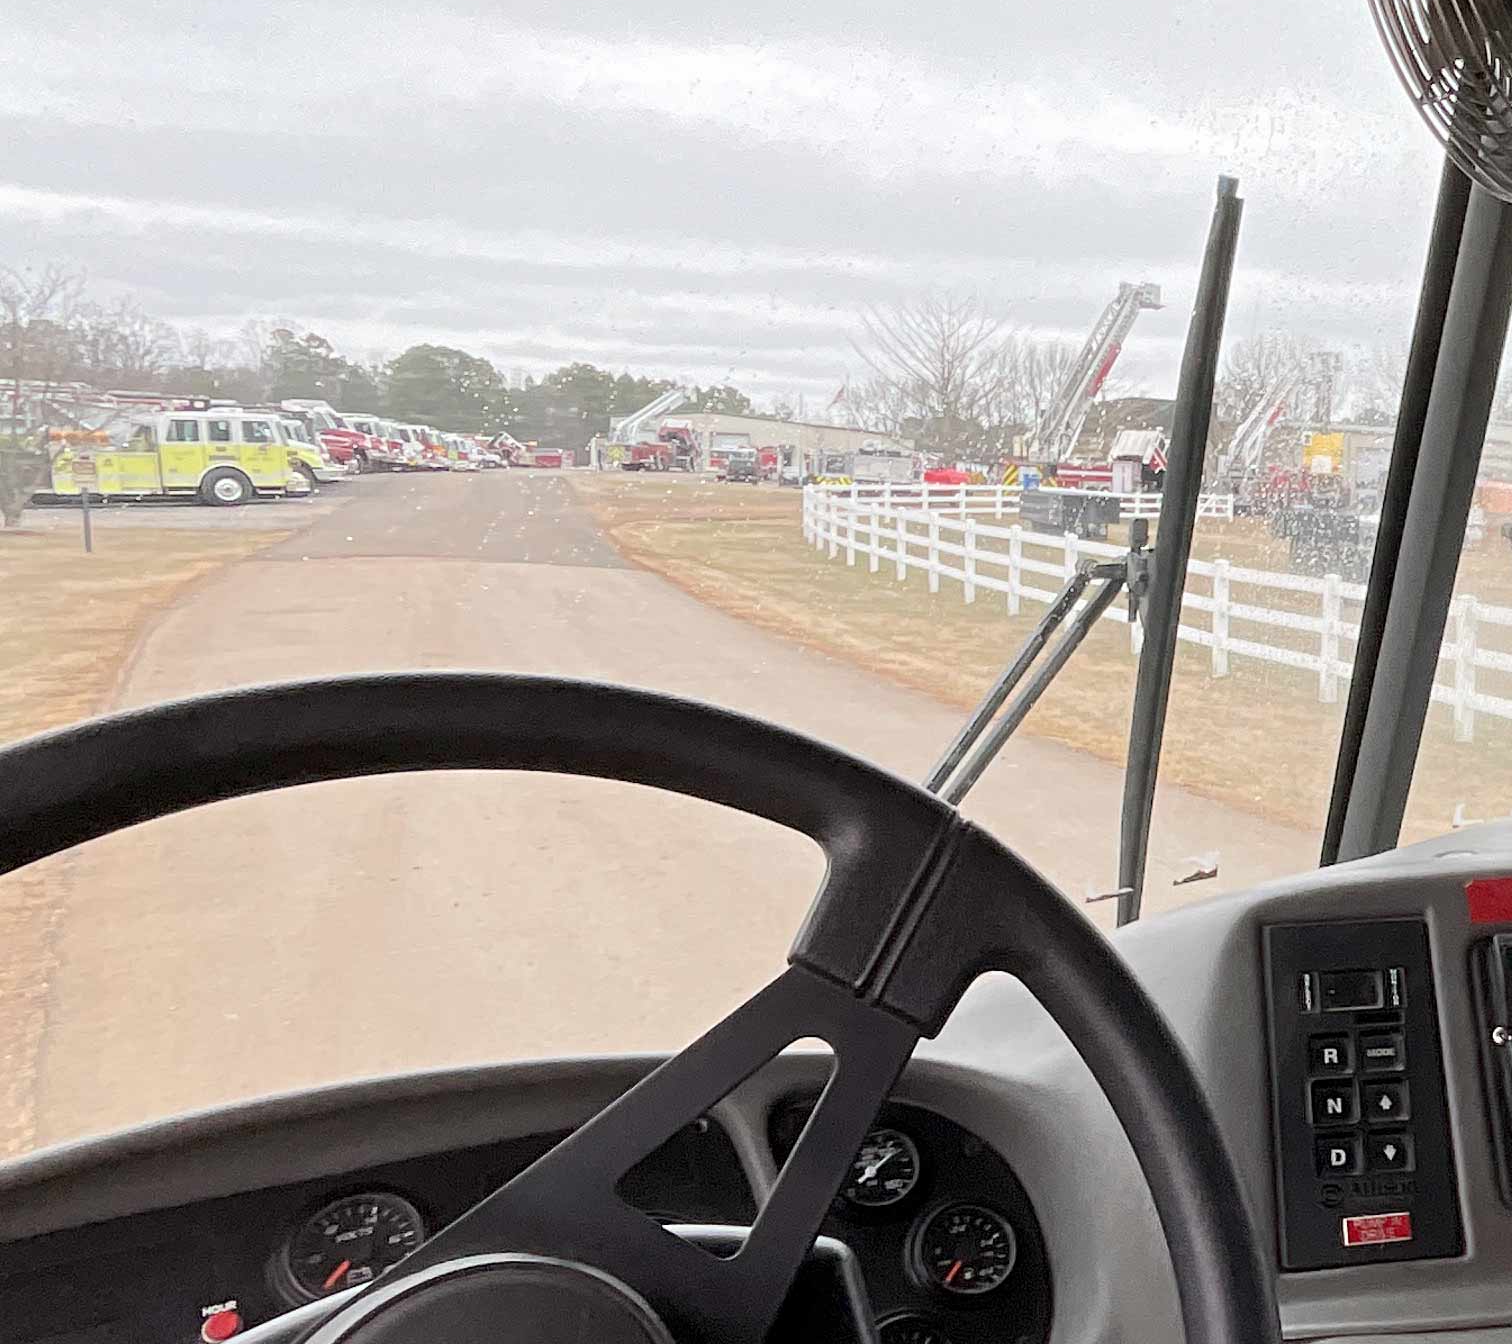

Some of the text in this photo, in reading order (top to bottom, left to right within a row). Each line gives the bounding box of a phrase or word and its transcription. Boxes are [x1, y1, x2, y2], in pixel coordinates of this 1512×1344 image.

[1323, 1048, 1339, 1065] R
[1326, 1097, 1343, 1115] N
[1330, 1148, 1347, 1167] D
